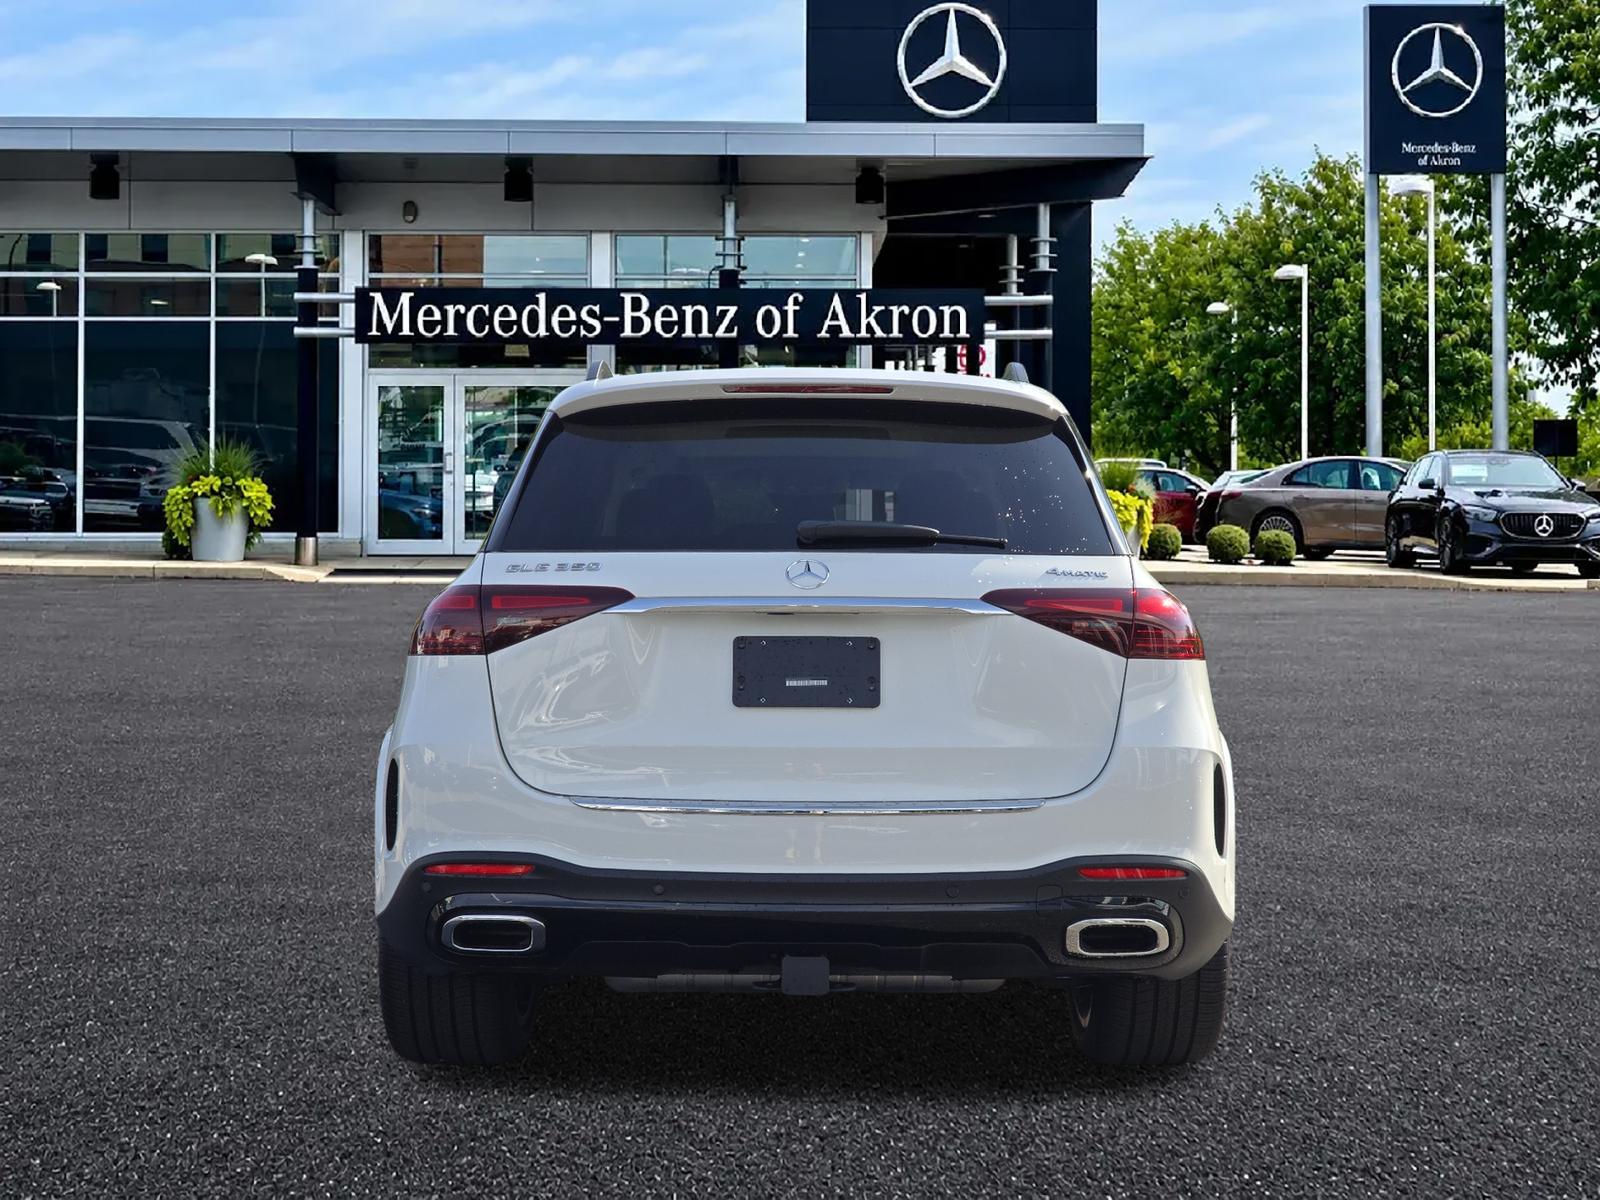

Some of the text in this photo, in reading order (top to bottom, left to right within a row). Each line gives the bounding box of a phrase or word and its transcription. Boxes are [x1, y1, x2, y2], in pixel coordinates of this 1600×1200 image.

[1401, 142, 1476, 153] Mercedes-Benz
[1418, 155, 1460, 165] of Akron
[367, 291, 971, 339] Mercedes-Benz of Akron
[504, 563, 551, 573] GLE
